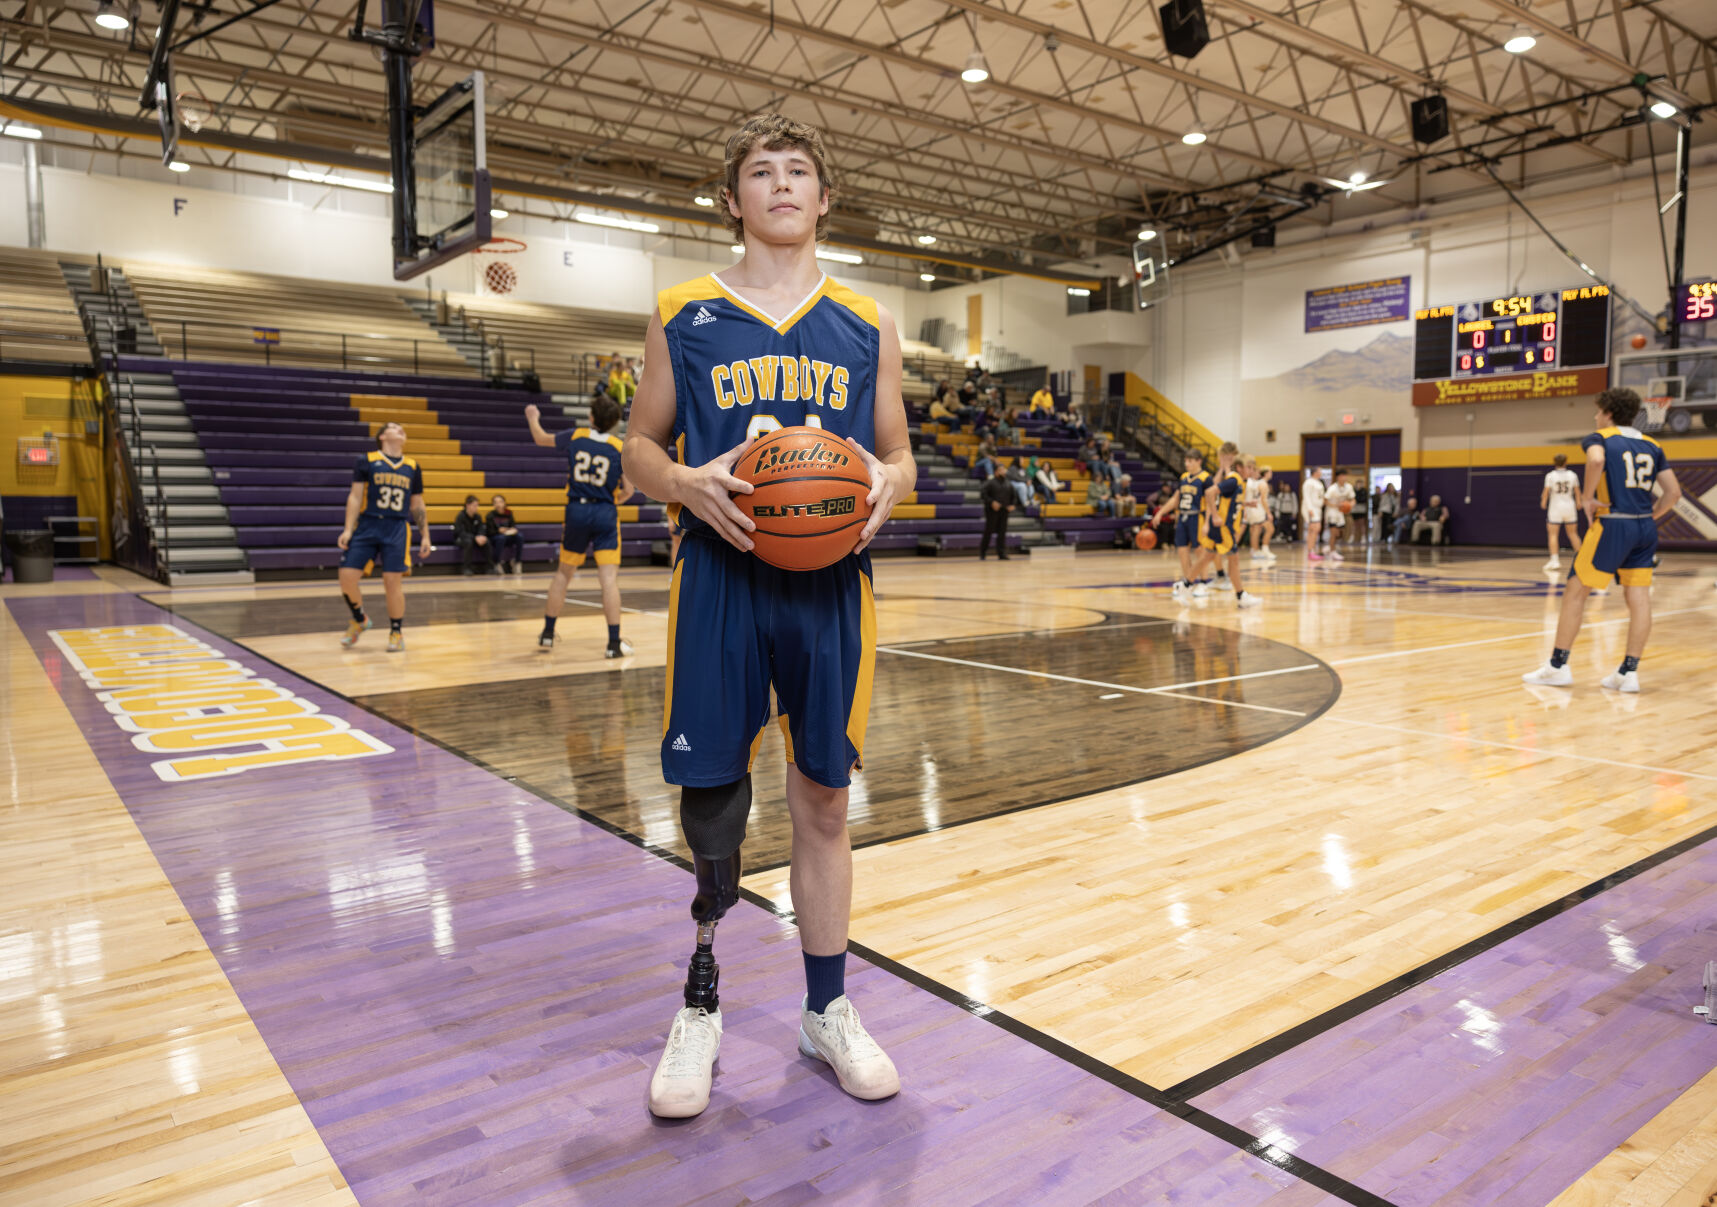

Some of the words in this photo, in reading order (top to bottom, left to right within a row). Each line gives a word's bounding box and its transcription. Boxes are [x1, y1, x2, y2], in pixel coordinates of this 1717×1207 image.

[173, 198, 188, 216] F
[563, 250, 574, 267] E
[1493, 296, 1532, 316] 9:54
[1686, 296, 1714, 319] 35
[692, 315, 717, 327] adidas
[1473, 330, 1485, 349] 0
[1504, 329, 1511, 343] 1
[1543, 322, 1556, 341] 0
[1461, 354, 1472, 370] 0
[1543, 346, 1555, 362] 0
[711, 355, 850, 411] COWBOYS
[573, 450, 611, 487] 23
[753, 442, 849, 476] Baden
[771, 463, 837, 475] PERFECTION
[1622, 451, 1655, 492] 12
[376, 485, 405, 511] 33
[672, 744, 692, 752] adidas
